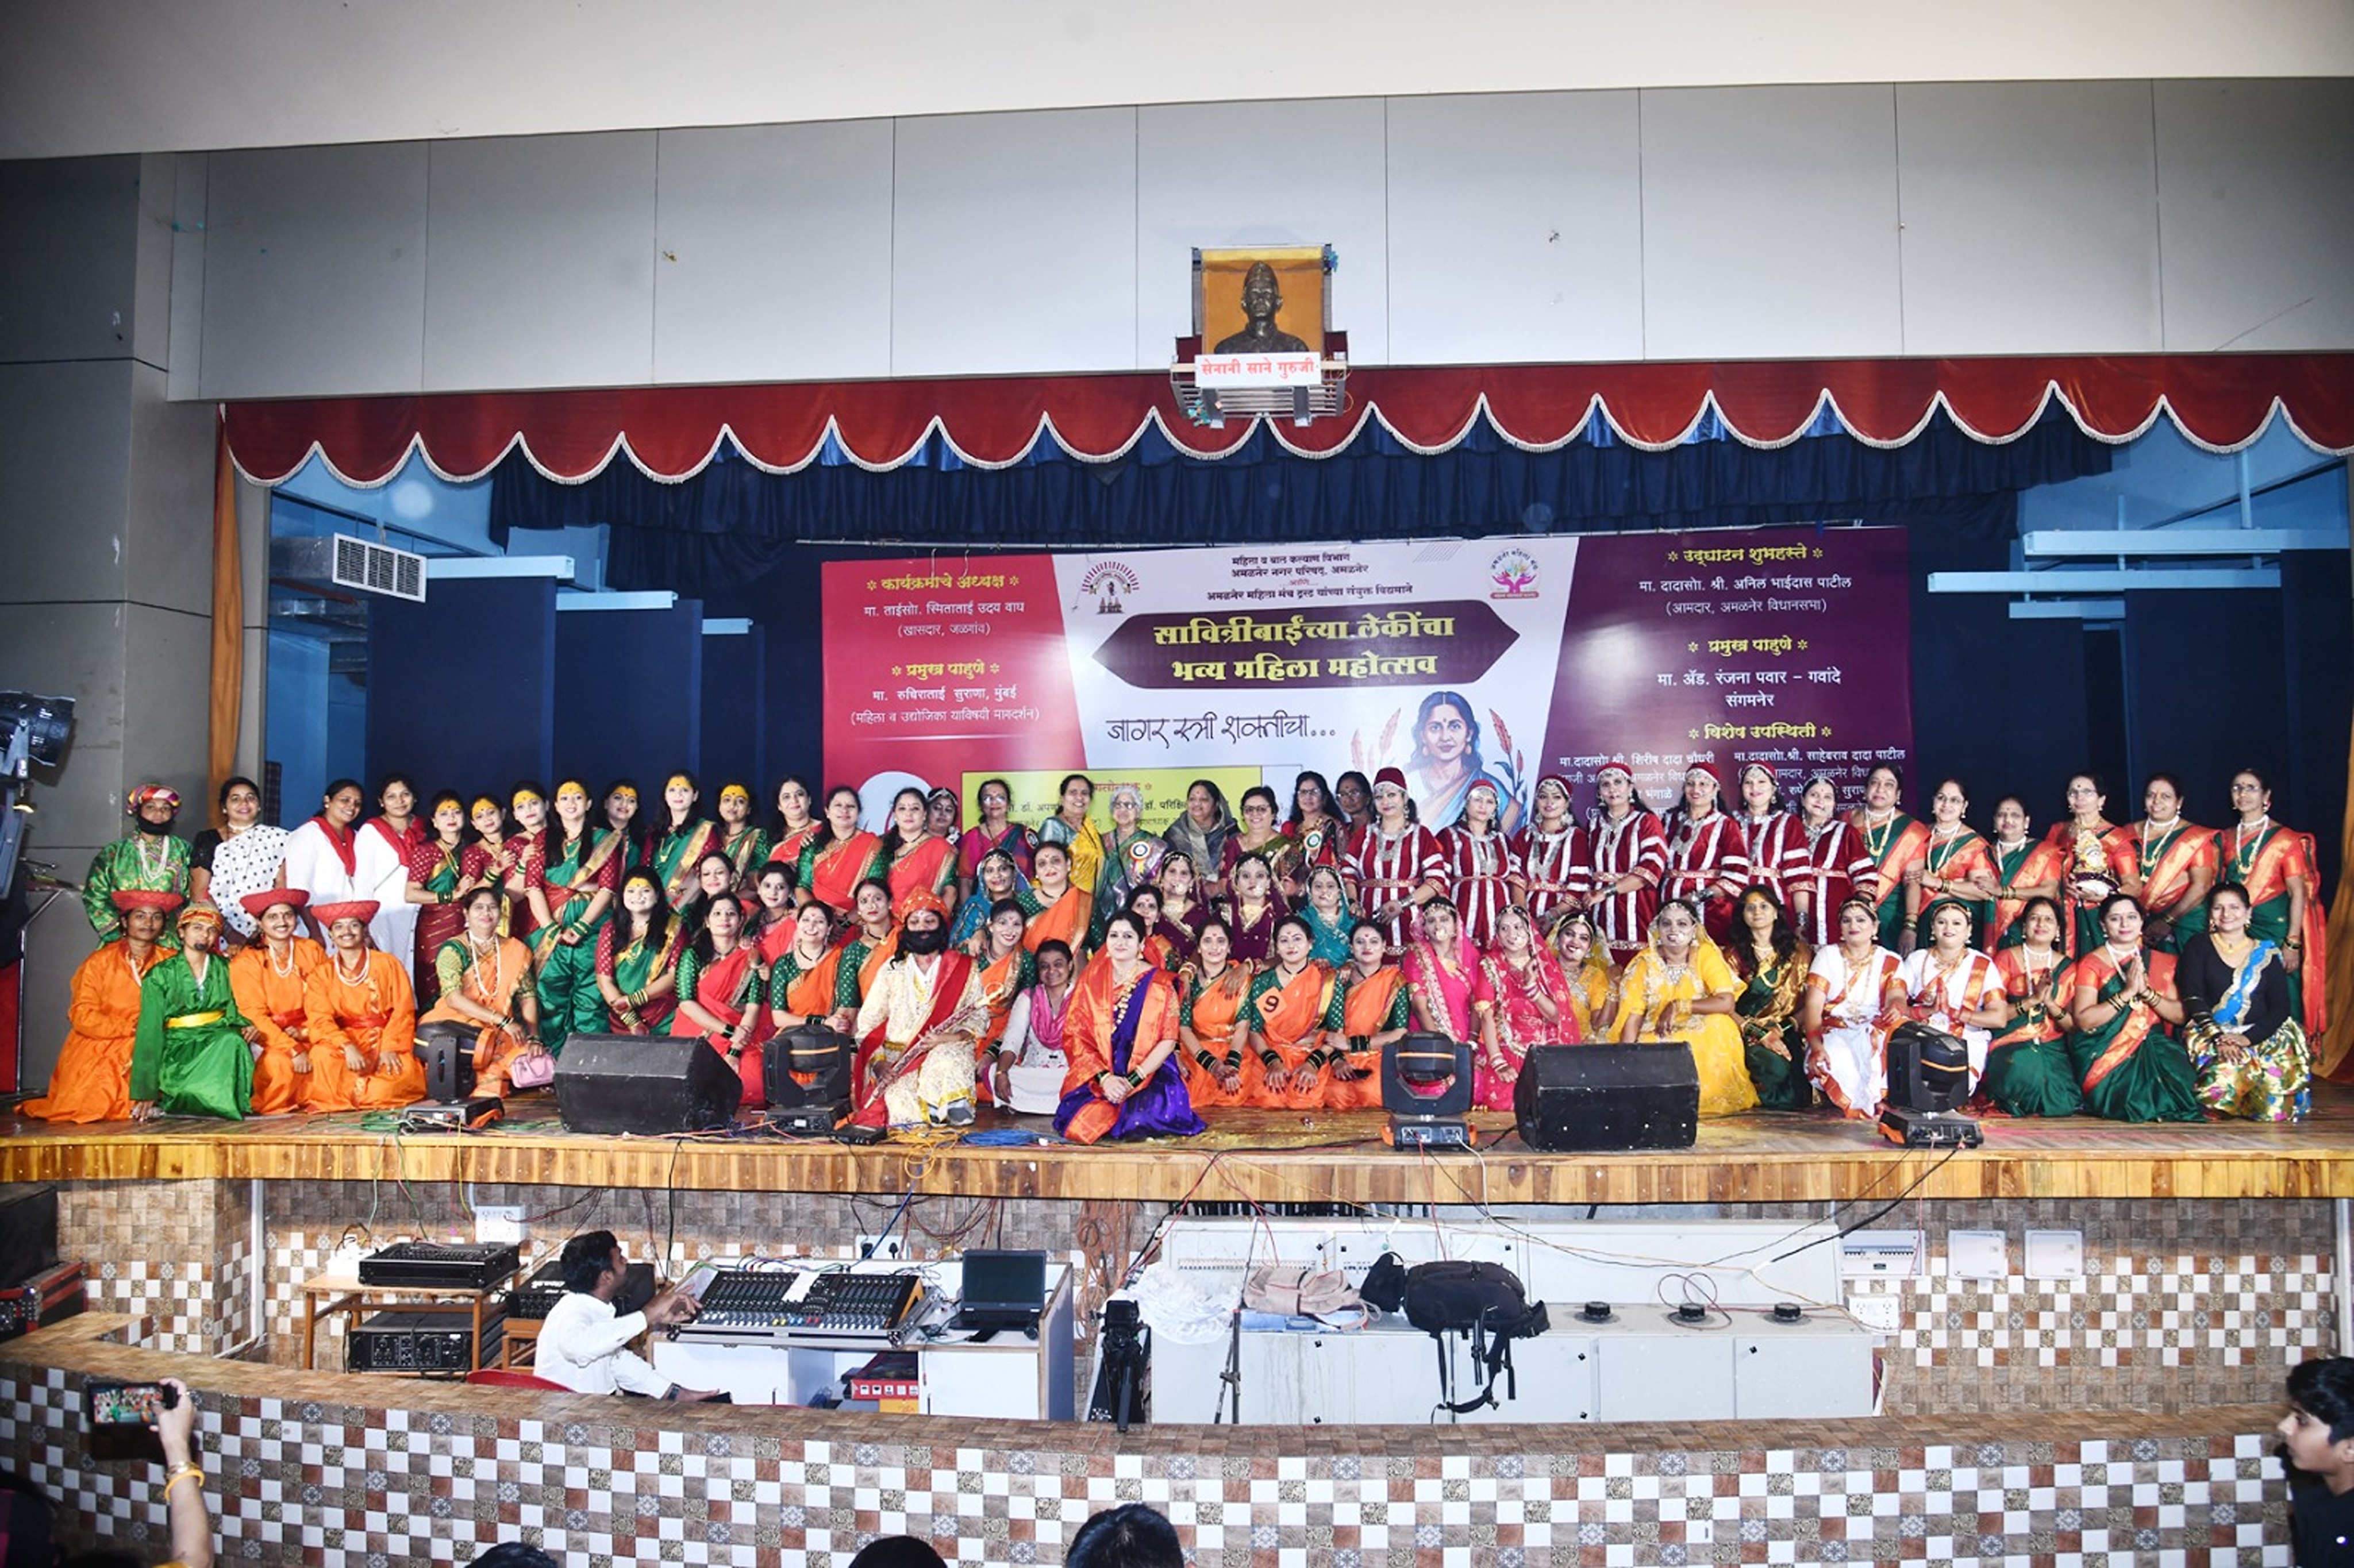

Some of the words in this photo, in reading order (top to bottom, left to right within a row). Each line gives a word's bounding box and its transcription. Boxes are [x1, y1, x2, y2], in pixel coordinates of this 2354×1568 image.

[1201, 358, 1240, 374] सेनानी
[1247, 357, 1272, 373] साने
[1278, 357, 1314, 379] गुरुजी
[1232, 554, 1258, 566] महिला
[1260, 556, 1267, 564] व
[1270, 556, 1287, 564] बाल
[1290, 554, 1320, 564] कल्याण
[1322, 552, 1350, 561] विभाग
[1749, 542, 1807, 565] शुभहस्ते
[1232, 566, 1268, 577] अमळनेर
[1271, 568, 1293, 576] नगर
[1332, 563, 1368, 574] अमळनेर
[957, 575, 1005, 590] अध्यक्ष
[1207, 588, 1244, 600] अमळनेर
[1247, 588, 1276, 600] महिला
[1279, 587, 1294, 598] मंच
[1376, 582, 1413, 594] विद्यमाने
[1639, 580, 1656, 592] मा.
[1710, 576, 1728, 591] श्री.
[1733, 575, 1767, 590] अनिल
[1771, 574, 1813, 591] भाईदास
[1817, 573, 1851, 589] पाटील
[864, 606, 879, 617] मा.
[926, 600, 974, 615] स्मिताताई
[978, 602, 1001, 614] उदय
[1005, 602, 1025, 612] वाघ
[1667, 602, 1714, 615] (आमदार,
[1721, 598, 1763, 613] अमळनेर
[1768, 596, 1826, 612] विधानसभा)
[898, 624, 945, 638] (खासदार,
[1153, 614, 1349, 646] सावित्रीबाईंच्या
[1356, 611, 1455, 639] लेकींचा
[1708, 639, 1748, 657] प्रमुख
[1752, 635, 1792, 656] पाहुणे
[907, 663, 944, 680] प्रमुख
[948, 658, 984, 679] पाहुणे
[1172, 660, 1226, 681] भव्य
[1234, 652, 1320, 681] महिला
[1327, 650, 1438, 678] महोत्सव
[1657, 672, 1677, 686] मा.
[1715, 668, 1750, 684] रंजना
[1756, 671, 1787, 684] पवार
[1807, 666, 1841, 684] गवांदे
[873, 690, 888, 701] मा.
[897, 686, 945, 700] रुचिराताई
[995, 684, 1017, 702] मुंबई
[1725, 690, 1774, 707] संगमनेर
[851, 708, 886, 726] (महिला
[889, 712, 897, 722] व
[1106, 718, 1170, 749] जागर
[1174, 711, 1217, 741] स्त्री
[1705, 722, 1746, 739] विशेष
[1750, 722, 1816, 739] उपस्थिती
[1663, 754, 1682, 765] दादा
[1806, 748, 1848, 763] साहेबराव
[1851, 750, 1872, 761] दादा
[1876, 746, 1905, 760] पाटील
